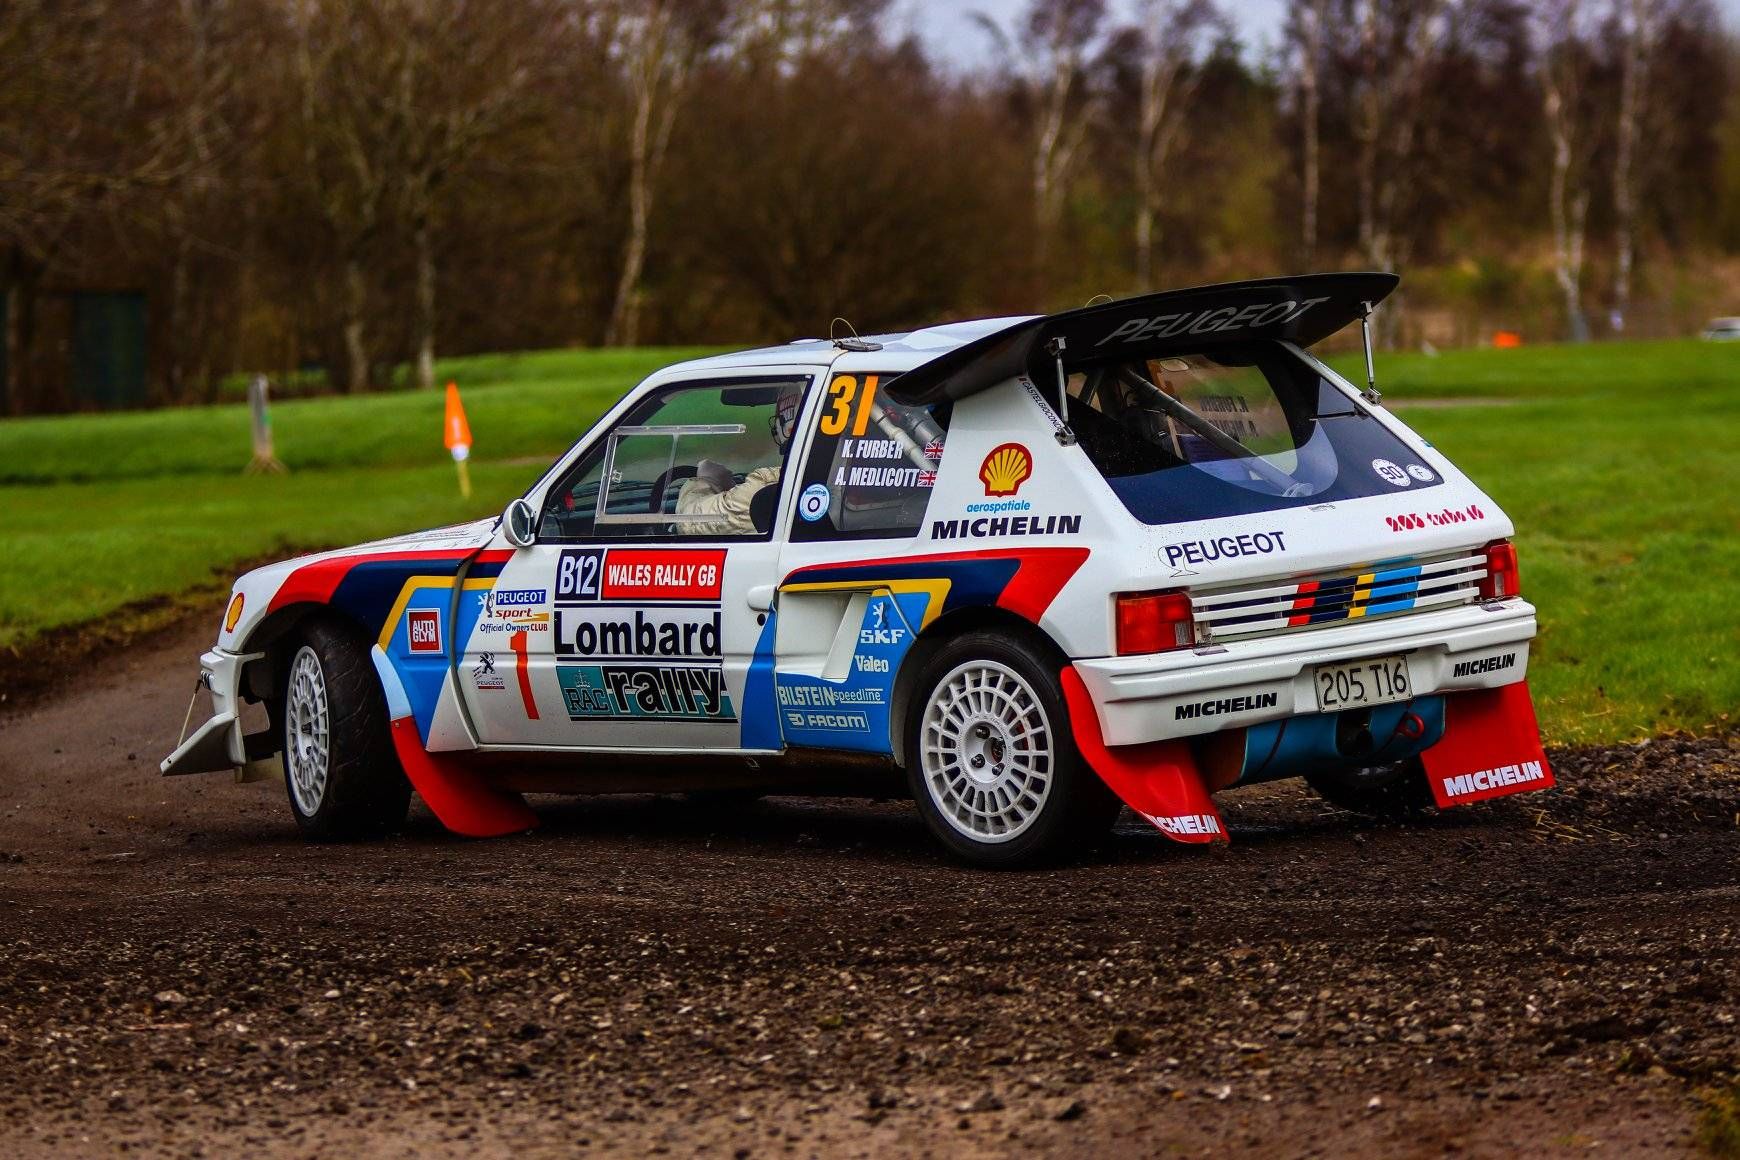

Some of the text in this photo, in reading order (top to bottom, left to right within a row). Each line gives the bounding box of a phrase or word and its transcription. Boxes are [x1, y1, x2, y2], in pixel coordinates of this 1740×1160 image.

[1094, 296, 1331, 347] PEUGEOT
[855, 440, 904, 459] FURBER
[834, 468, 920, 487] A. MEDLICOTT
[966, 499, 1031, 514] aerospatiale
[931, 515, 1082, 540] MICHELIN
[1165, 531, 1286, 567] PEUGEOT
[558, 555, 599, 595] B12
[608, 564, 717, 586] WALES RALLY GB
[497, 591, 545, 604] PEUGEOT
[495, 608, 533, 620] sport
[412, 620, 435, 631] AUTO
[413, 630, 436, 642] GLYM
[480, 622, 548, 633] Official Owners CLUB
[554, 610, 722, 656] Lombard
[860, 629, 906, 644] SKF
[854, 655, 890, 673] Valeo
[1453, 653, 1516, 677] MICHELIN
[608, 668, 722, 715] rally
[1320, 662, 1407, 705] 205 T16
[565, 687, 610, 712] RAC
[777, 686, 836, 706] BILSTEIN
[833, 689, 881, 703] speedline
[1175, 693, 1277, 720] MICHELIN
[1443, 760, 1545, 797] MICHELIN
